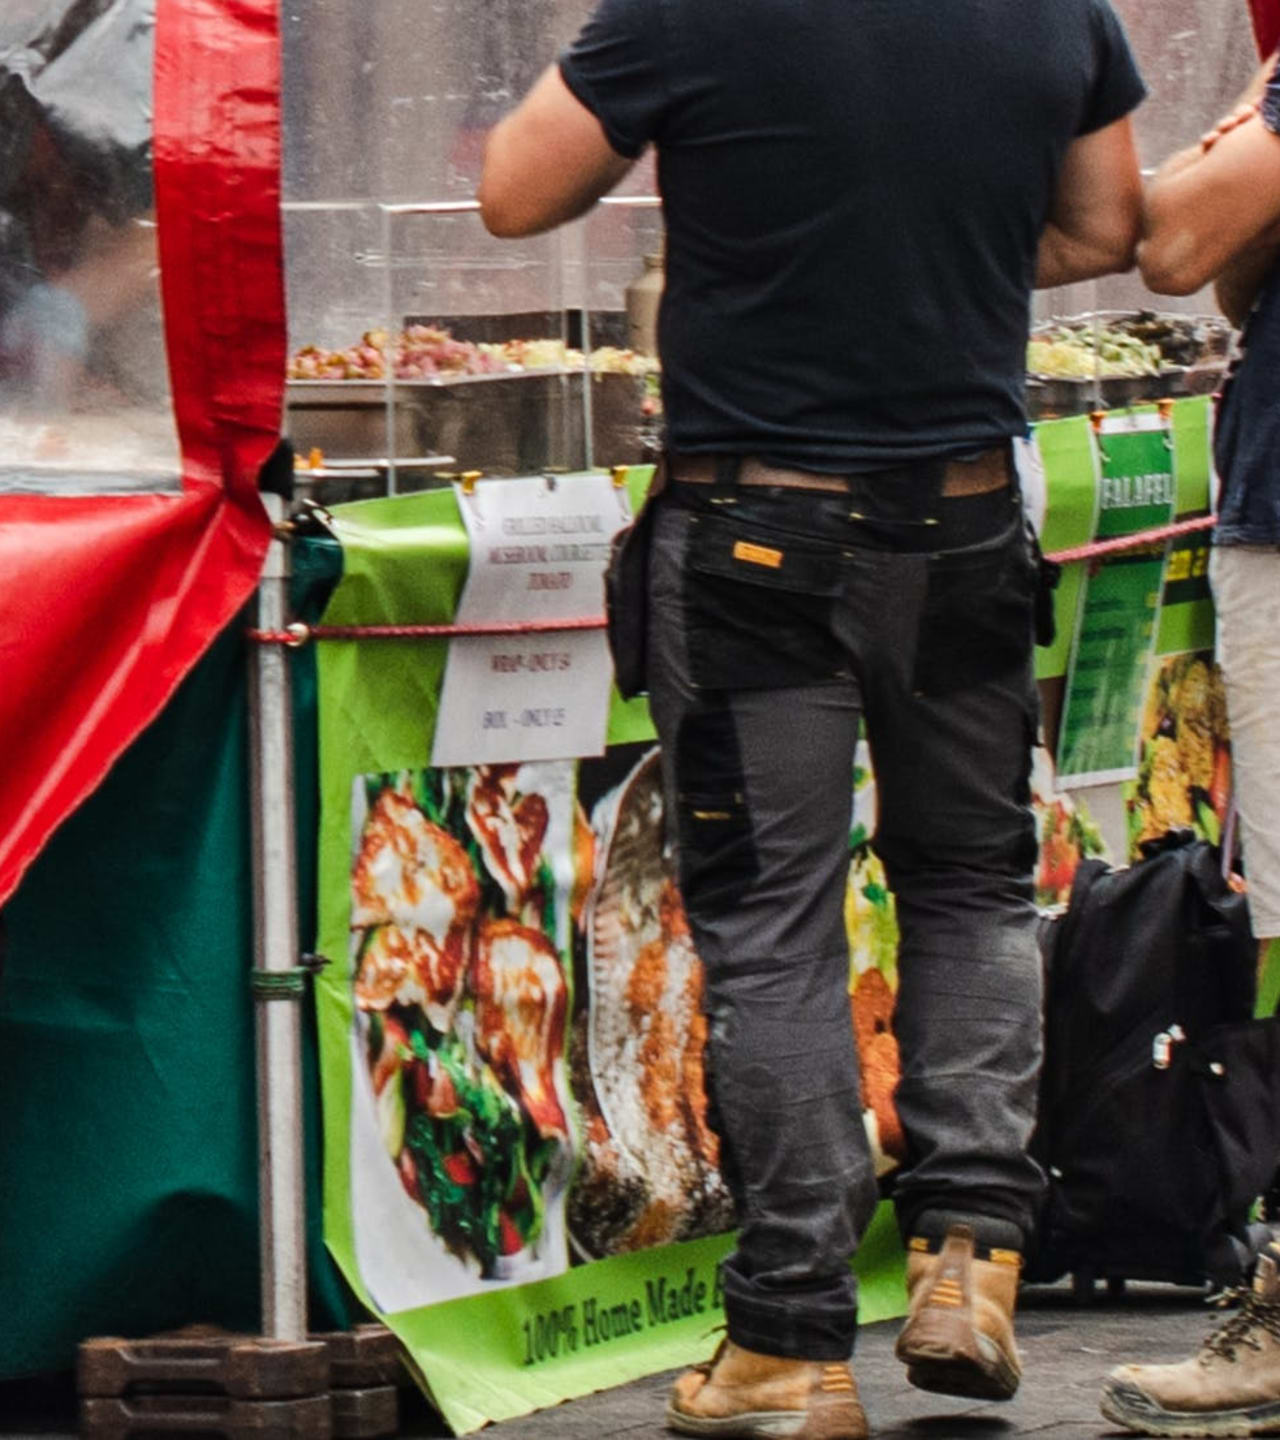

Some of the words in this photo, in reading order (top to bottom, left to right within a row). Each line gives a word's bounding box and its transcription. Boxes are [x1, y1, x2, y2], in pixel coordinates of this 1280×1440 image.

[523, 1303, 579, 1366] 100%
[582, 1297, 643, 1347] Home
[645, 1267, 707, 1328] Made
